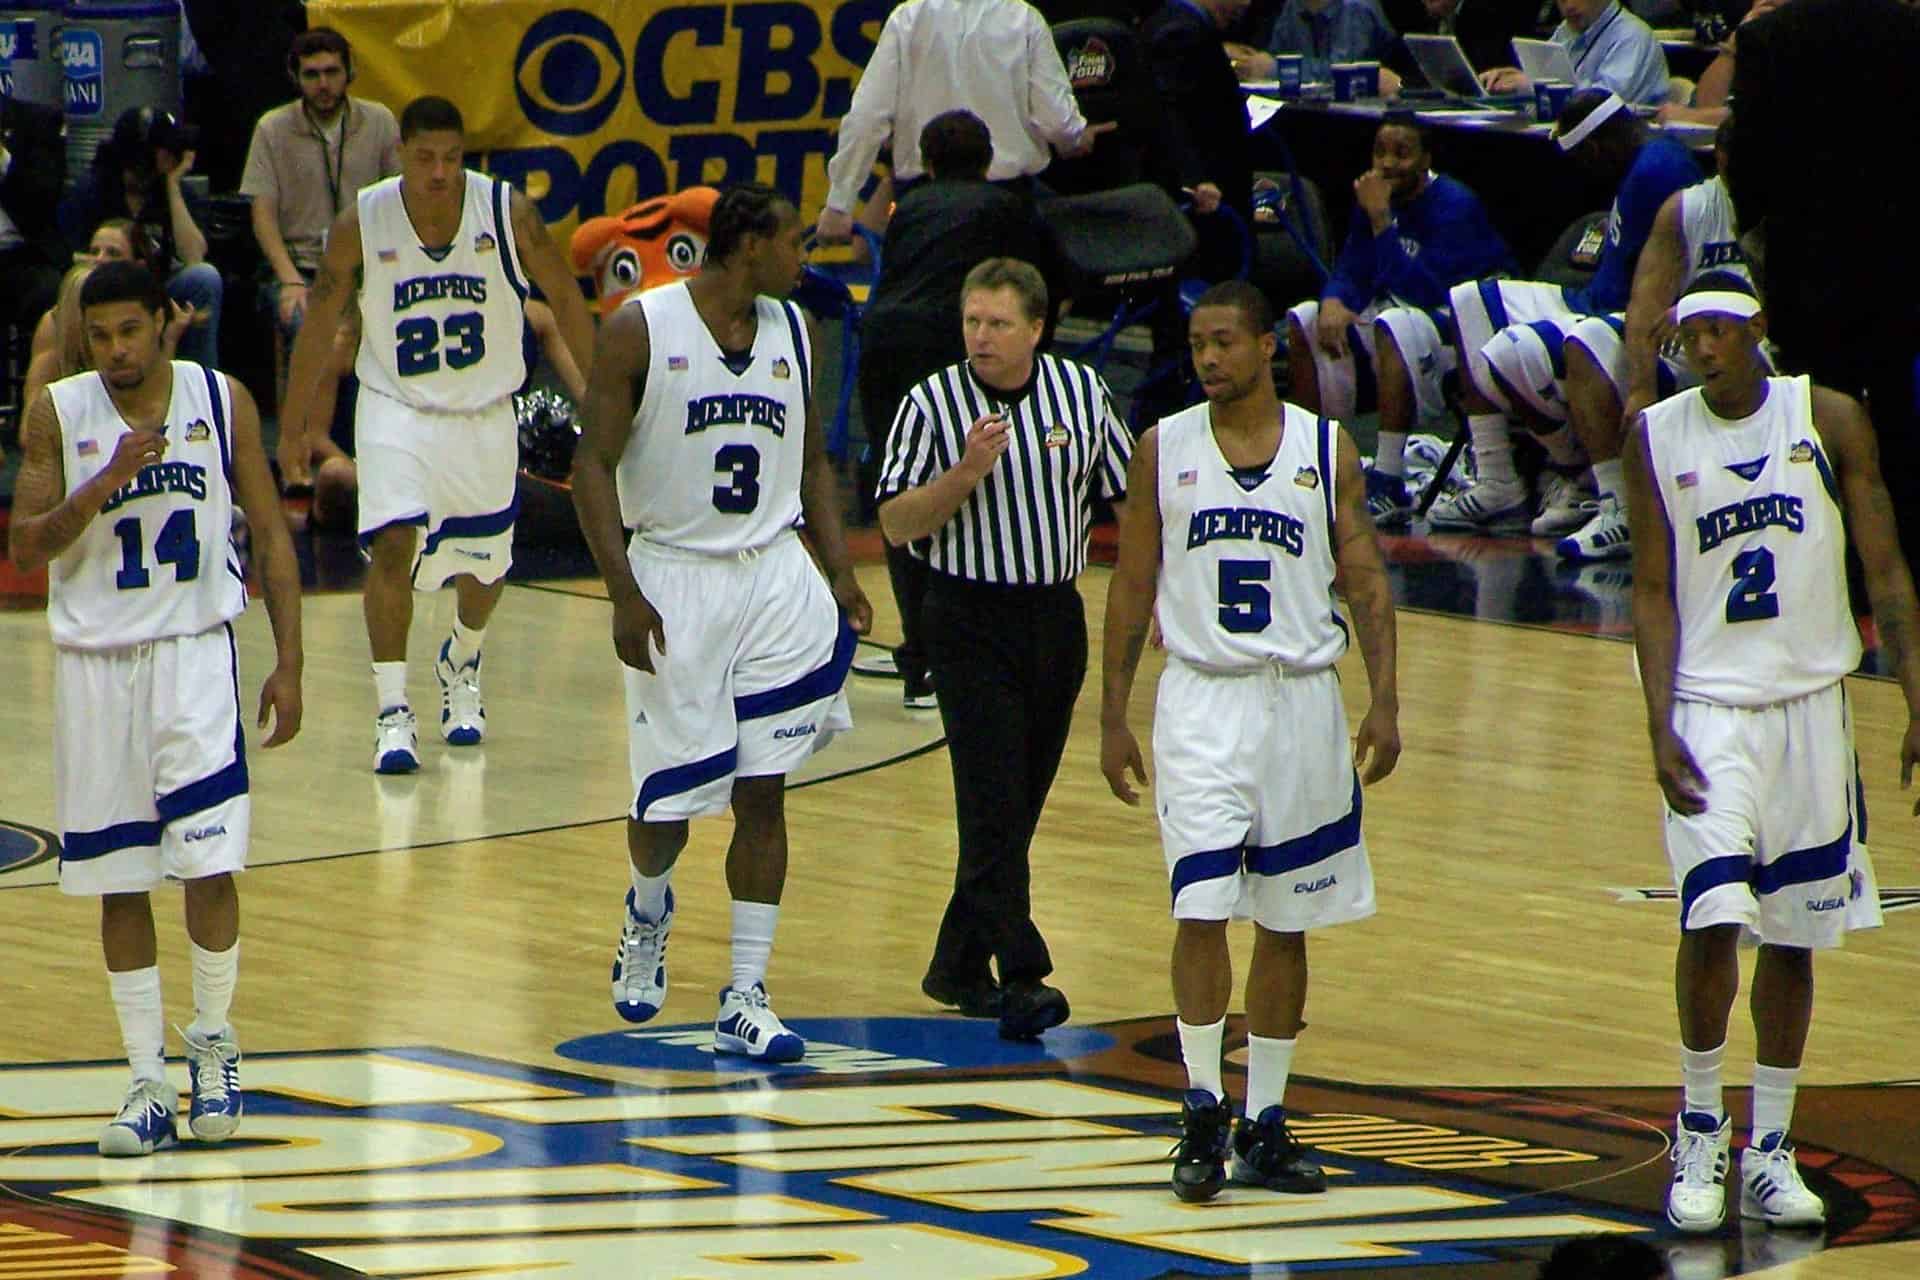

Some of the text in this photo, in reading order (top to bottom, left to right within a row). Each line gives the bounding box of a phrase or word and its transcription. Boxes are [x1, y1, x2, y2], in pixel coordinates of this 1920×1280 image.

[634, 1, 896, 126] CBS
[393, 272, 487, 312] MEMPHIS
[396, 311, 486, 377] 23
[684, 393, 787, 440] MEMPHIS
[712, 444, 761, 514] 3
[114, 509, 200, 590] 14
[1187, 506, 1304, 558] MEMPHIS
[1696, 493, 1805, 555] MEMPHIS
[1218, 559, 1272, 633] 5
[1726, 545, 1780, 624] 2
